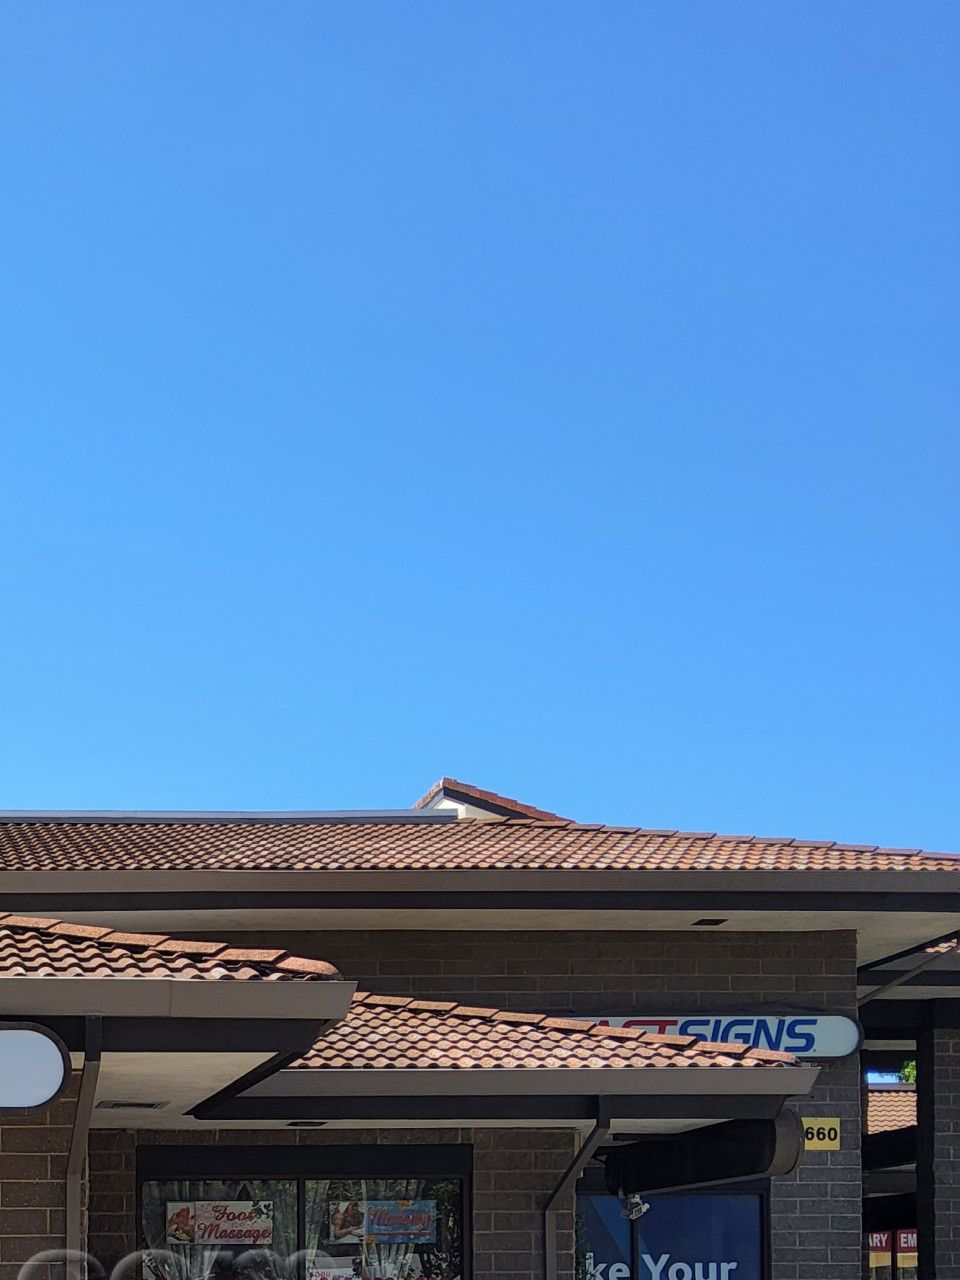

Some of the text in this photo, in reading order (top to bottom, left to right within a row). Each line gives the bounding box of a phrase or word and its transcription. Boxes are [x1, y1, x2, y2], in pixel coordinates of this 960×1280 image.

[805, 1127, 838, 1141] 660
[197, 1223, 272, 1244] Massage
[900, 1233, 917, 1247] EM
